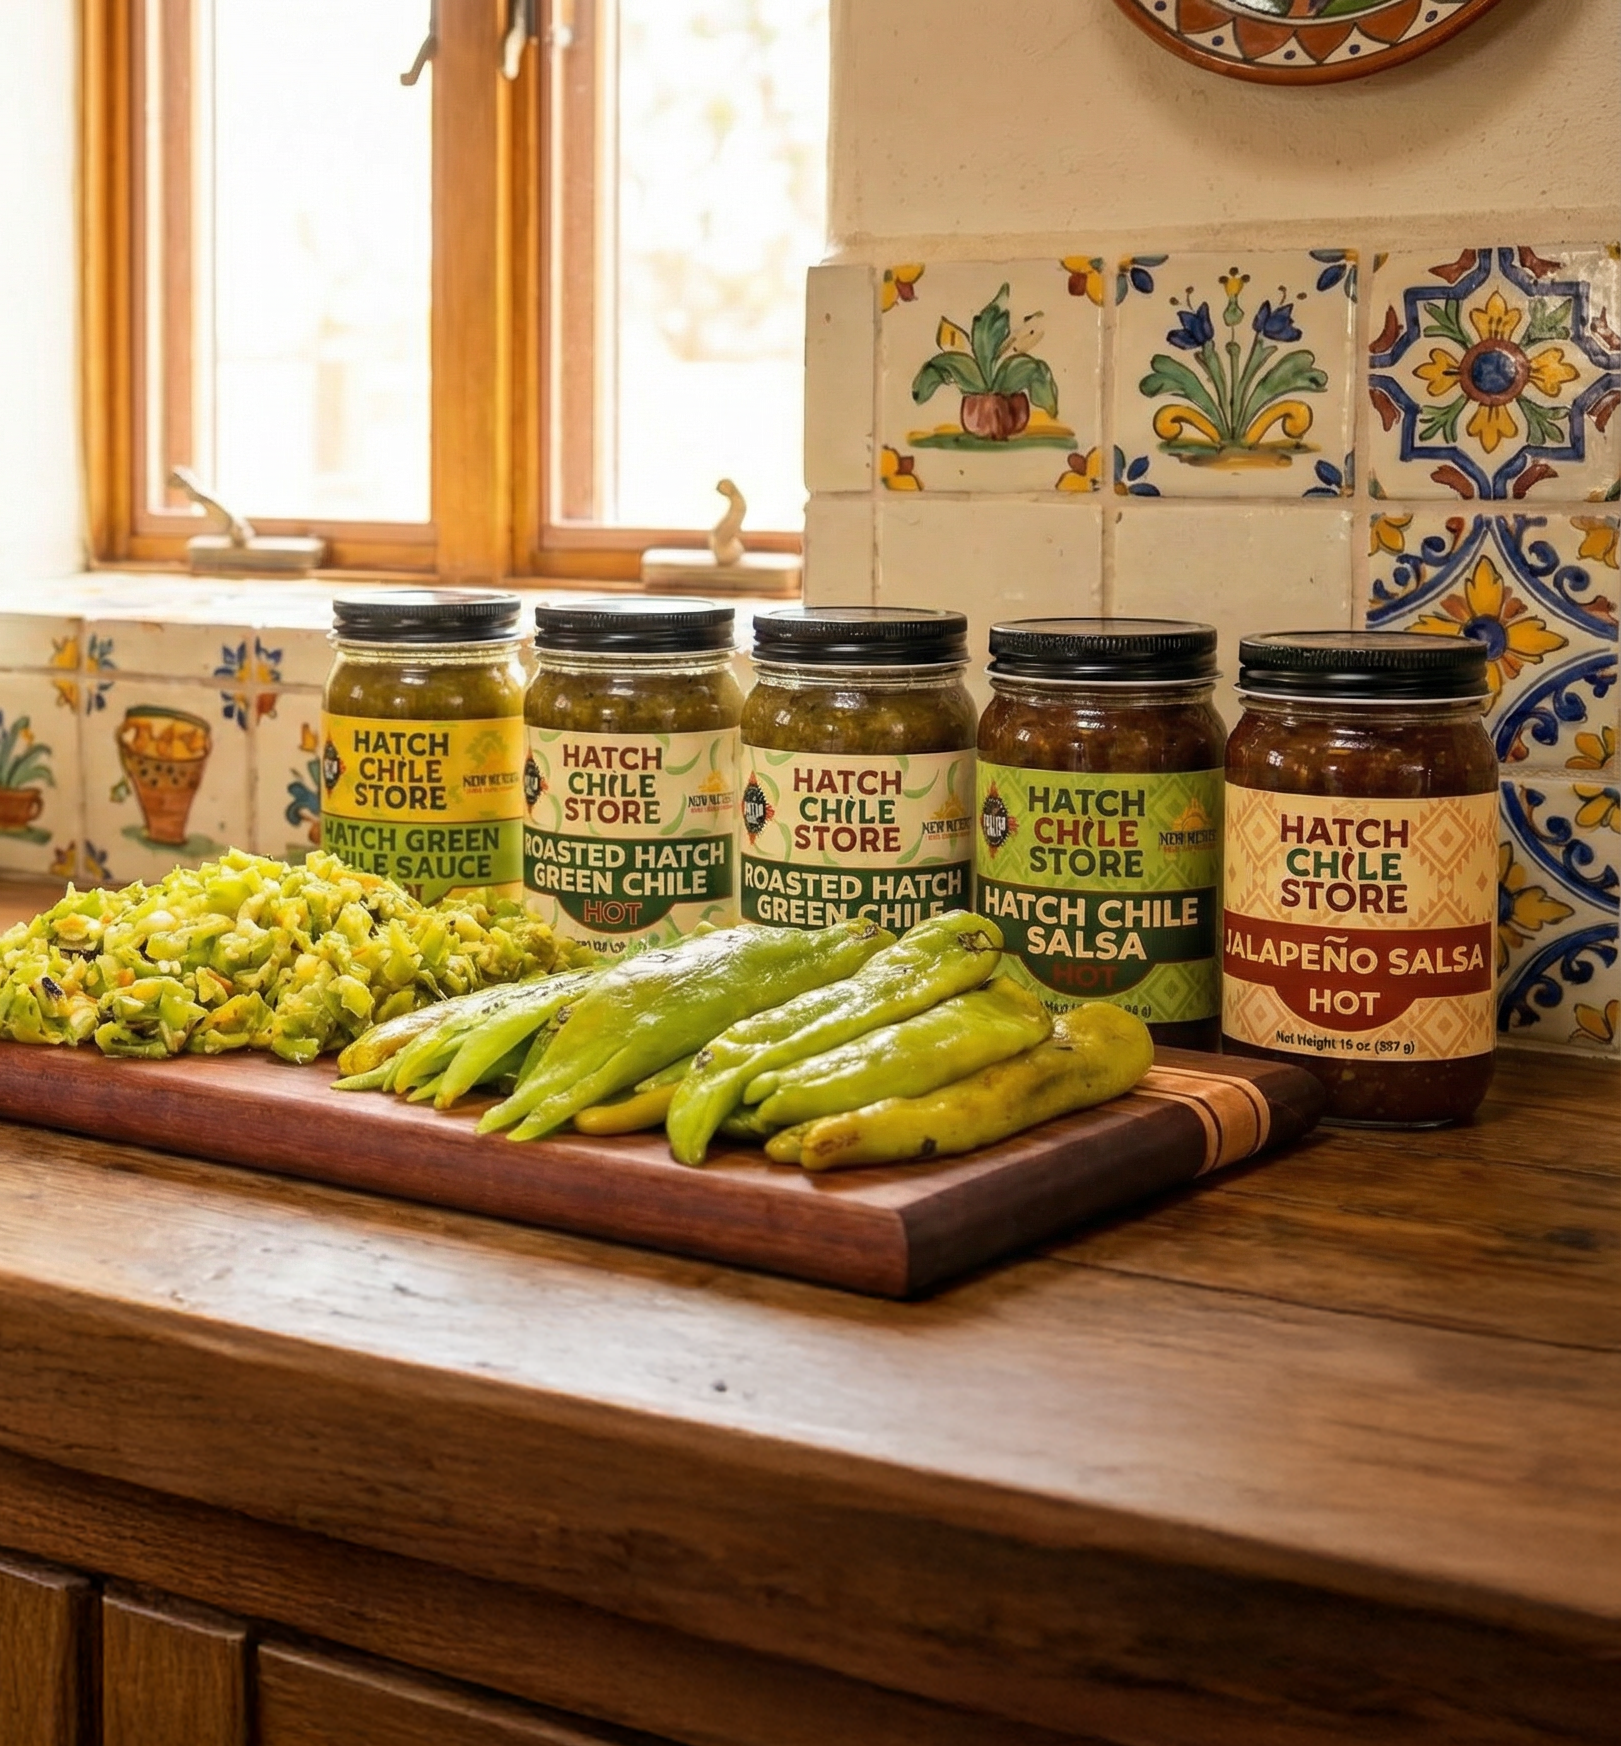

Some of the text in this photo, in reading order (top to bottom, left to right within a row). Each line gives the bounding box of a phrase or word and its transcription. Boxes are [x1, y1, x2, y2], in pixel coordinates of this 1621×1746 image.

[353, 730, 450, 757] HATCH
[562, 744, 663, 771] HATCH
[359, 756, 443, 784] CHILE
[568, 770, 657, 799] CHILE
[793, 768, 902, 796] HATCH
[354, 782, 447, 811] STORE
[565, 798, 661, 825] STORE
[799, 795, 896, 825] CHILE
[1028, 786, 1146, 818] HATCH
[324, 818, 500, 853] HATCH GREEN
[794, 824, 902, 853] STORE
[1034, 816, 1139, 848] CHILE
[1280, 813, 1409, 848] HATCH
[328, 847, 492, 879] HILE SAUCE
[525, 832, 725, 869] ROASTED HATCH
[1029, 846, 1144, 878] STORE
[1286, 847, 1402, 882] CHILE
[533, 863, 707, 896] GREEN CHILE
[744, 862, 962, 900] ROASTED HATCH
[583, 899, 643, 925] HOT
[757, 895, 847, 926] GREEN
[984, 885, 1199, 928] HATCH CHILE
[1280, 878, 1408, 914] STORE
[1026, 927, 1147, 961] SALSA
[1225, 926, 1484, 976] JALAPEÑO SALSA
[1052, 962, 1118, 988] HOT
[1309, 988, 1381, 1016] HOT
